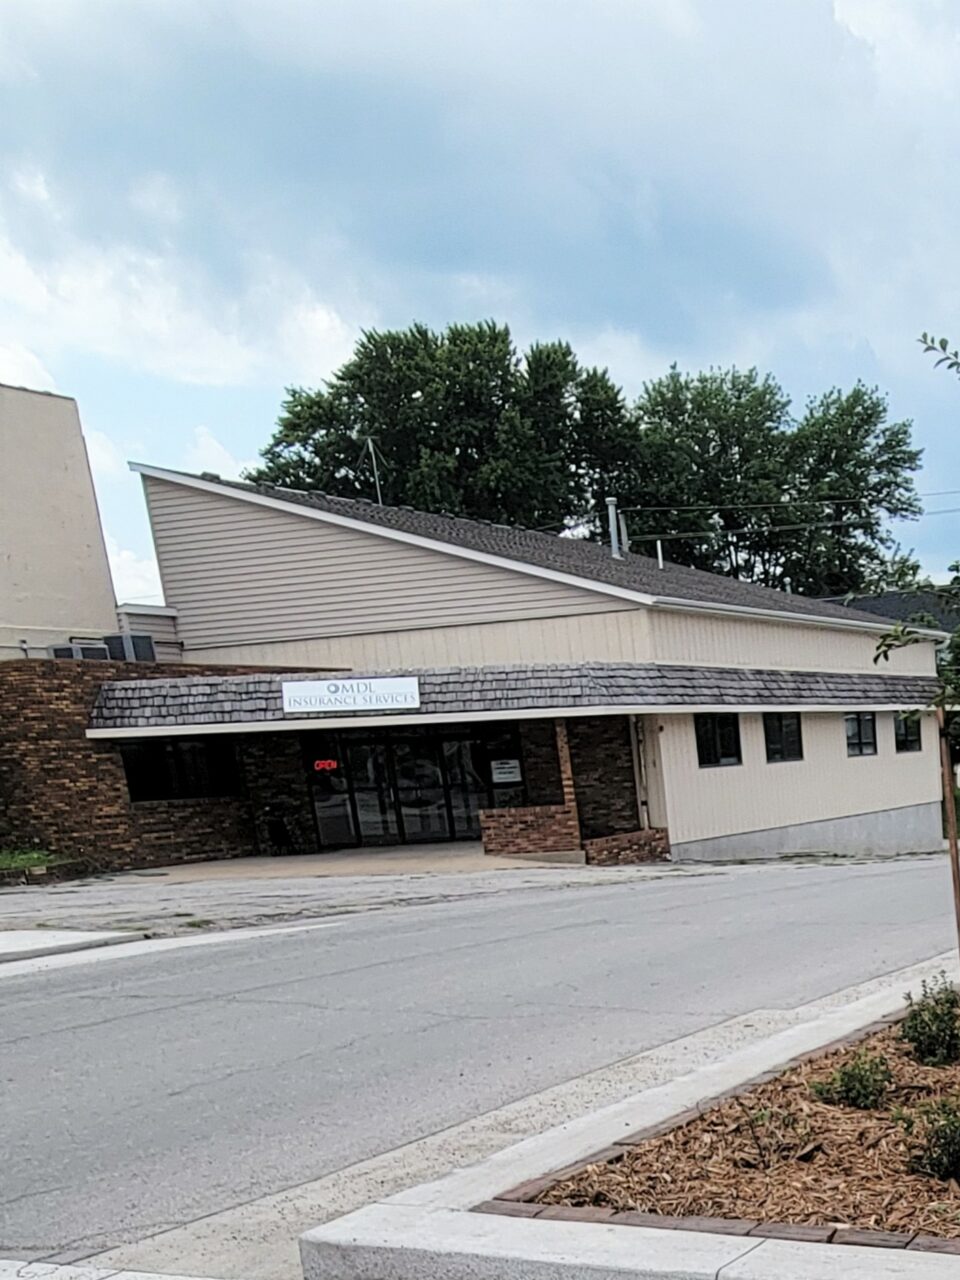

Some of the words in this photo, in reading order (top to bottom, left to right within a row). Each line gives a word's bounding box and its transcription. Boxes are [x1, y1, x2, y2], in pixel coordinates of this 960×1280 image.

[288, 695, 357, 707] INSURANCE
[362, 693, 416, 705] SERVICES
[314, 760, 337, 770] OPEN
